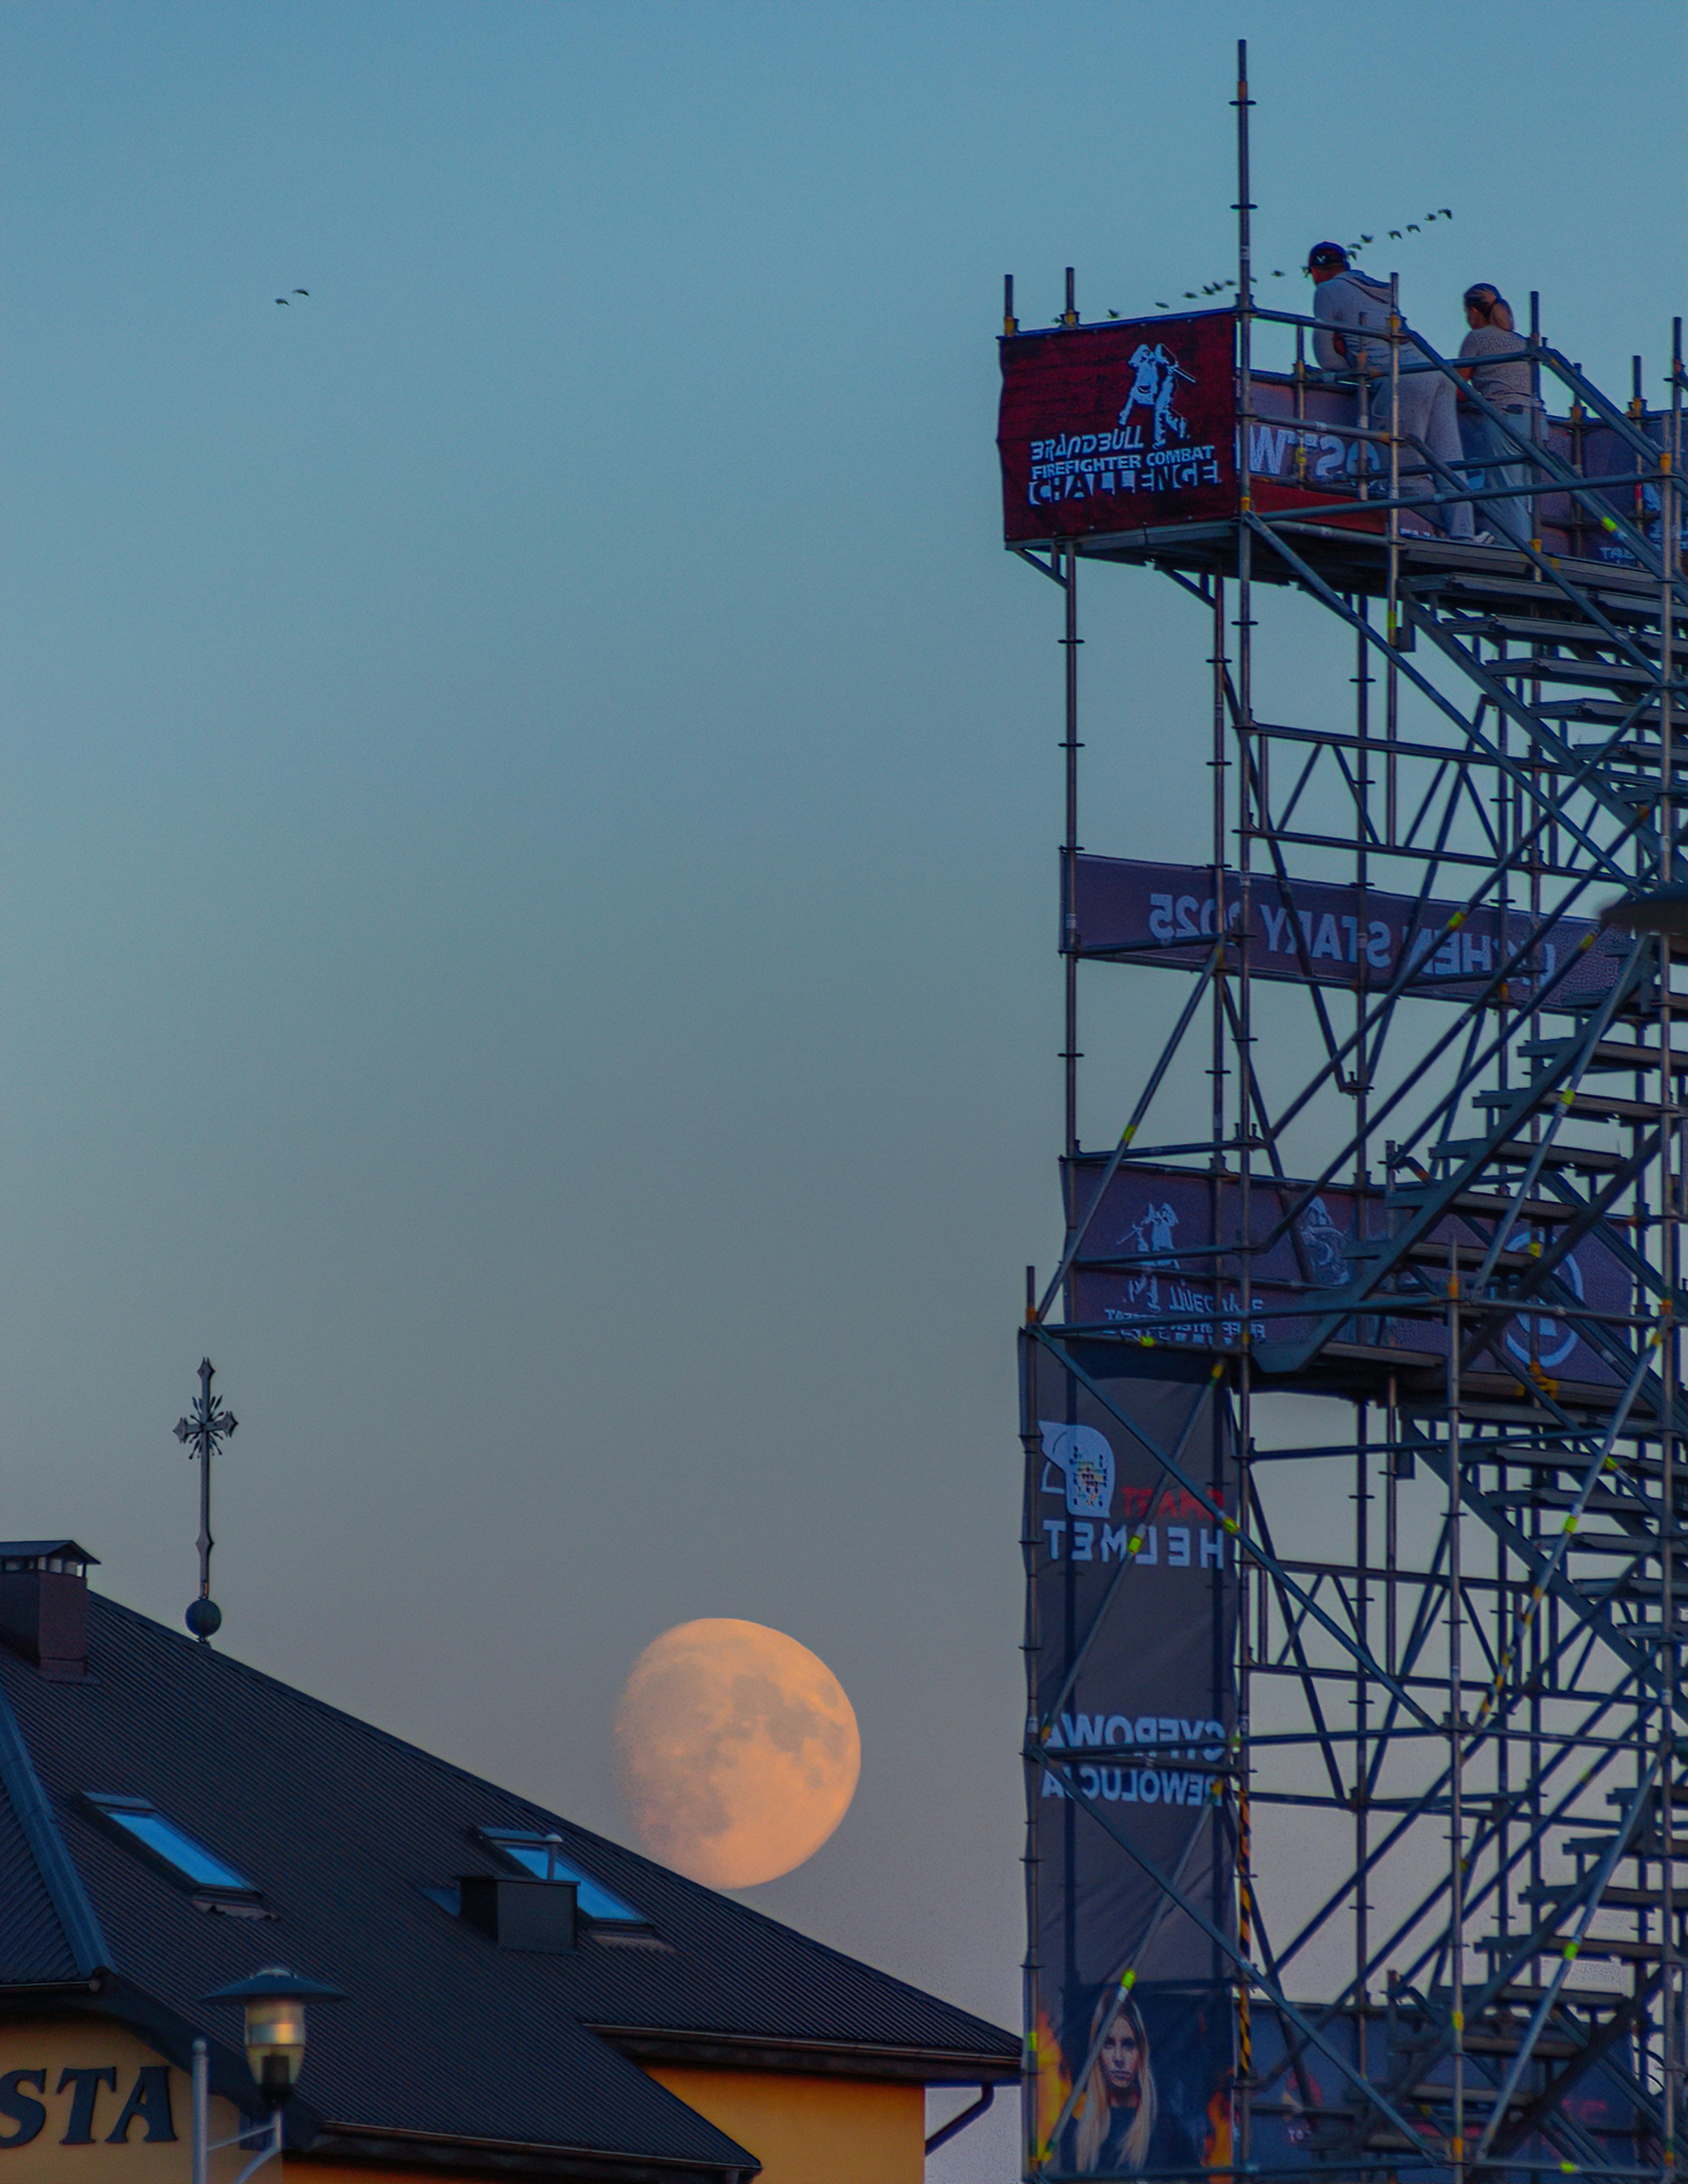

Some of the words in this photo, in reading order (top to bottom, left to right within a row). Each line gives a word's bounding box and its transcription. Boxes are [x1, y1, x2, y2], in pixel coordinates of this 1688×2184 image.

[1030, 425, 1144, 461] BRANDBULL
[1031, 454, 1141, 480] FIREFIGHTER
[1146, 445, 1215, 467] COMBAT
[1028, 459, 1219, 506] CHALLENGE
